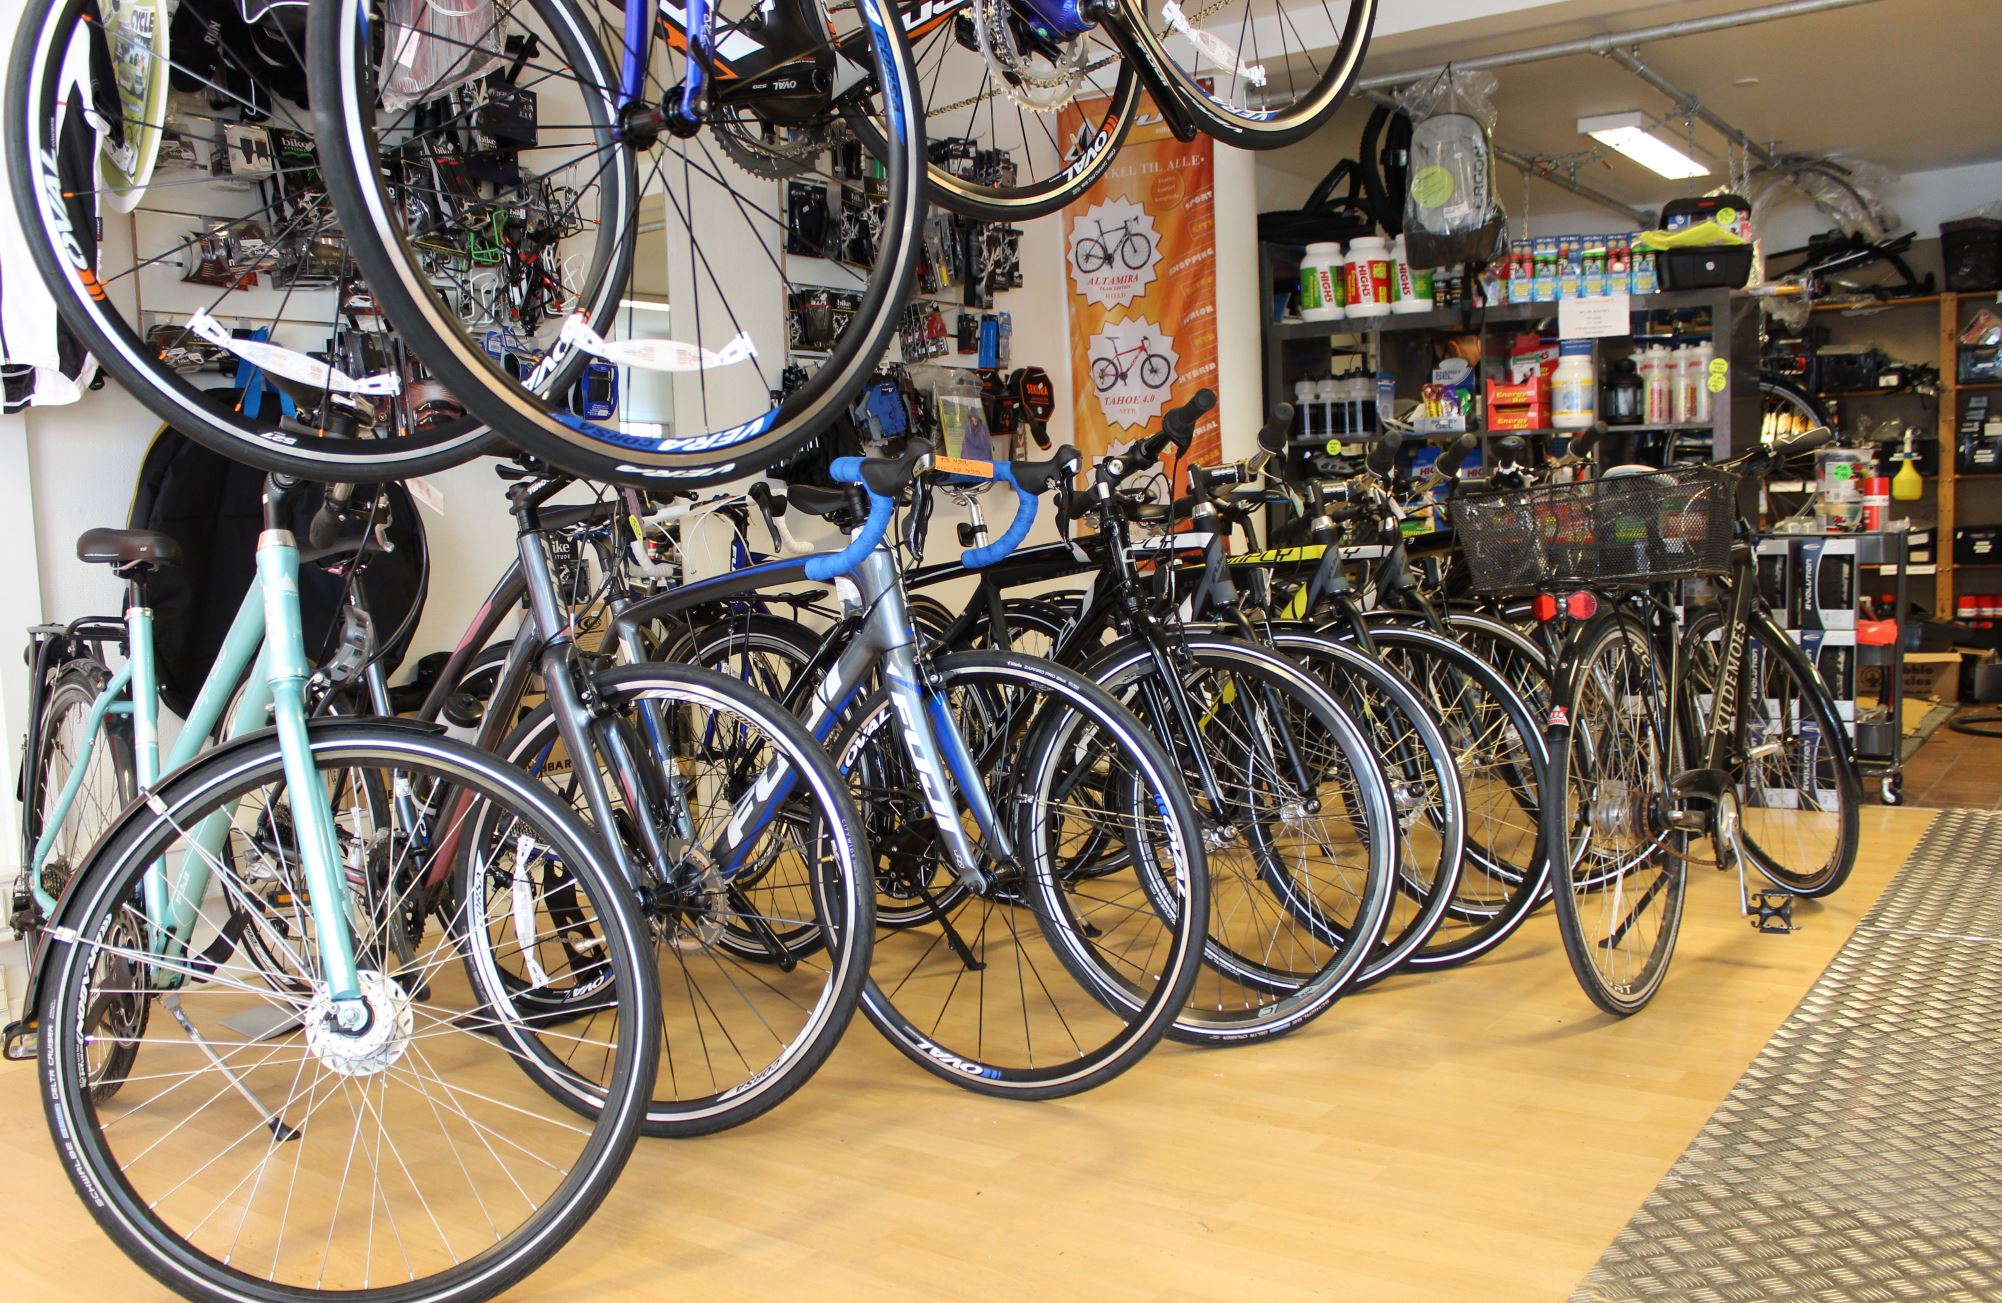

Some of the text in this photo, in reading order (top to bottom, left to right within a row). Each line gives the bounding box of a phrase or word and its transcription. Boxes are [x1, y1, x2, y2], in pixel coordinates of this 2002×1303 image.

[772, 80, 797, 92] OVAL
[281, 136, 314, 152] bik
[1062, 130, 1108, 182] OVAL
[41, 149, 88, 270] OVAL
[1168, 247, 1214, 276] SHOPPING
[1087, 273, 1140, 286] ALTAMIRA
[1177, 361, 1217, 384] HYBRID
[1104, 395, 1140, 406] TAHOE
[1496, 391, 1528, 399] Energy
[656, 416, 766, 452] VERA
[1497, 417, 1529, 425] Energy
[1804, 558, 1813, 610] EVOLUTION
[1715, 621, 1746, 735] KILDEMOES
[1751, 648, 1759, 699] EVOLUTION
[726, 709, 774, 742] CORSA
[844, 708, 892, 768] OVAL
[889, 690, 957, 833] FUJI
[1162, 814, 1186, 898] OVAL
[563, 975, 605, 999] OVAL
[917, 1037, 985, 1076] OVAL
[735, 1058, 781, 1093] CORSA
[46, 1024, 105, 1208] SCHWALBE DELTA CRUISER
